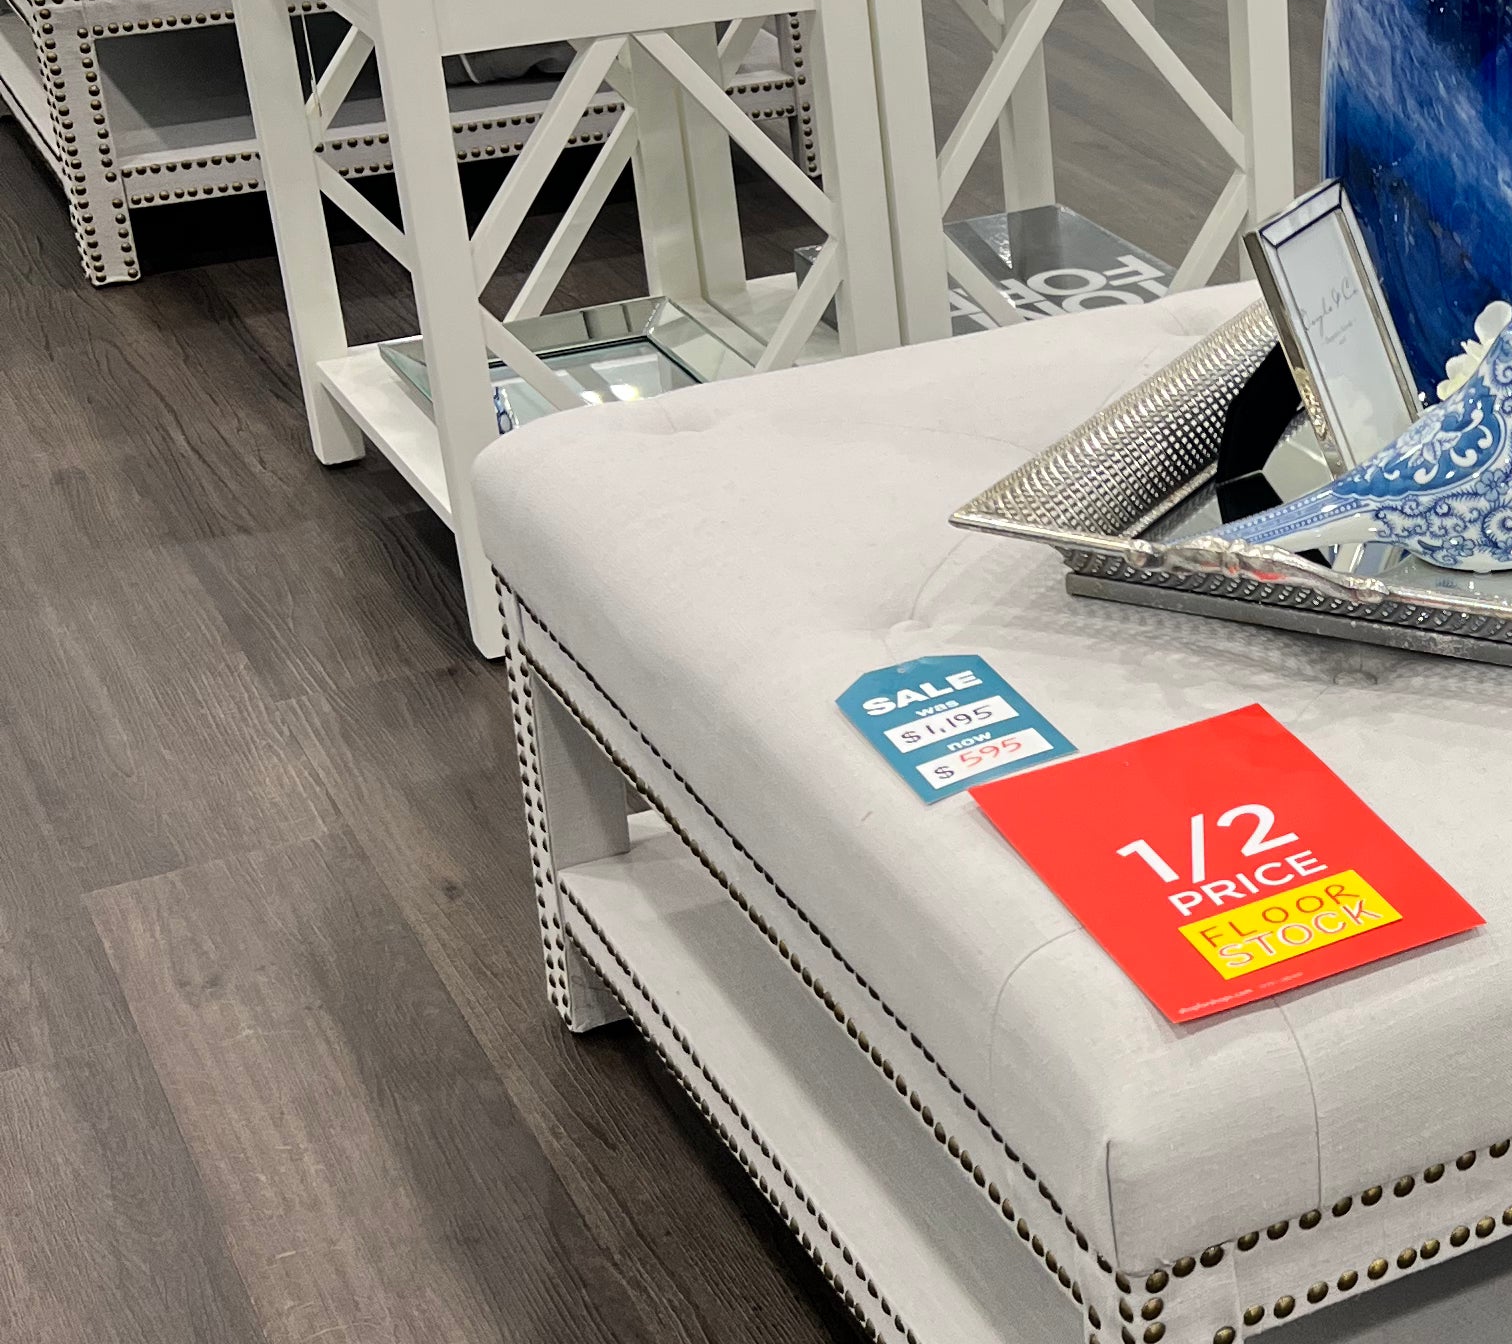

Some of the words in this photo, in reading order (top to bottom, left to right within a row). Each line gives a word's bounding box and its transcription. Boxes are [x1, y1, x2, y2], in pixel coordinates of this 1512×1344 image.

[862, 669, 984, 717] SALE
[915, 699, 960, 718] was
[946, 731, 992, 752] now
[1116, 803, 1300, 884] 1/2
[1167, 849, 1329, 917] PRICE
[1200, 884, 1361, 948] FLOOR
[1218, 898, 1383, 968] STOCK
